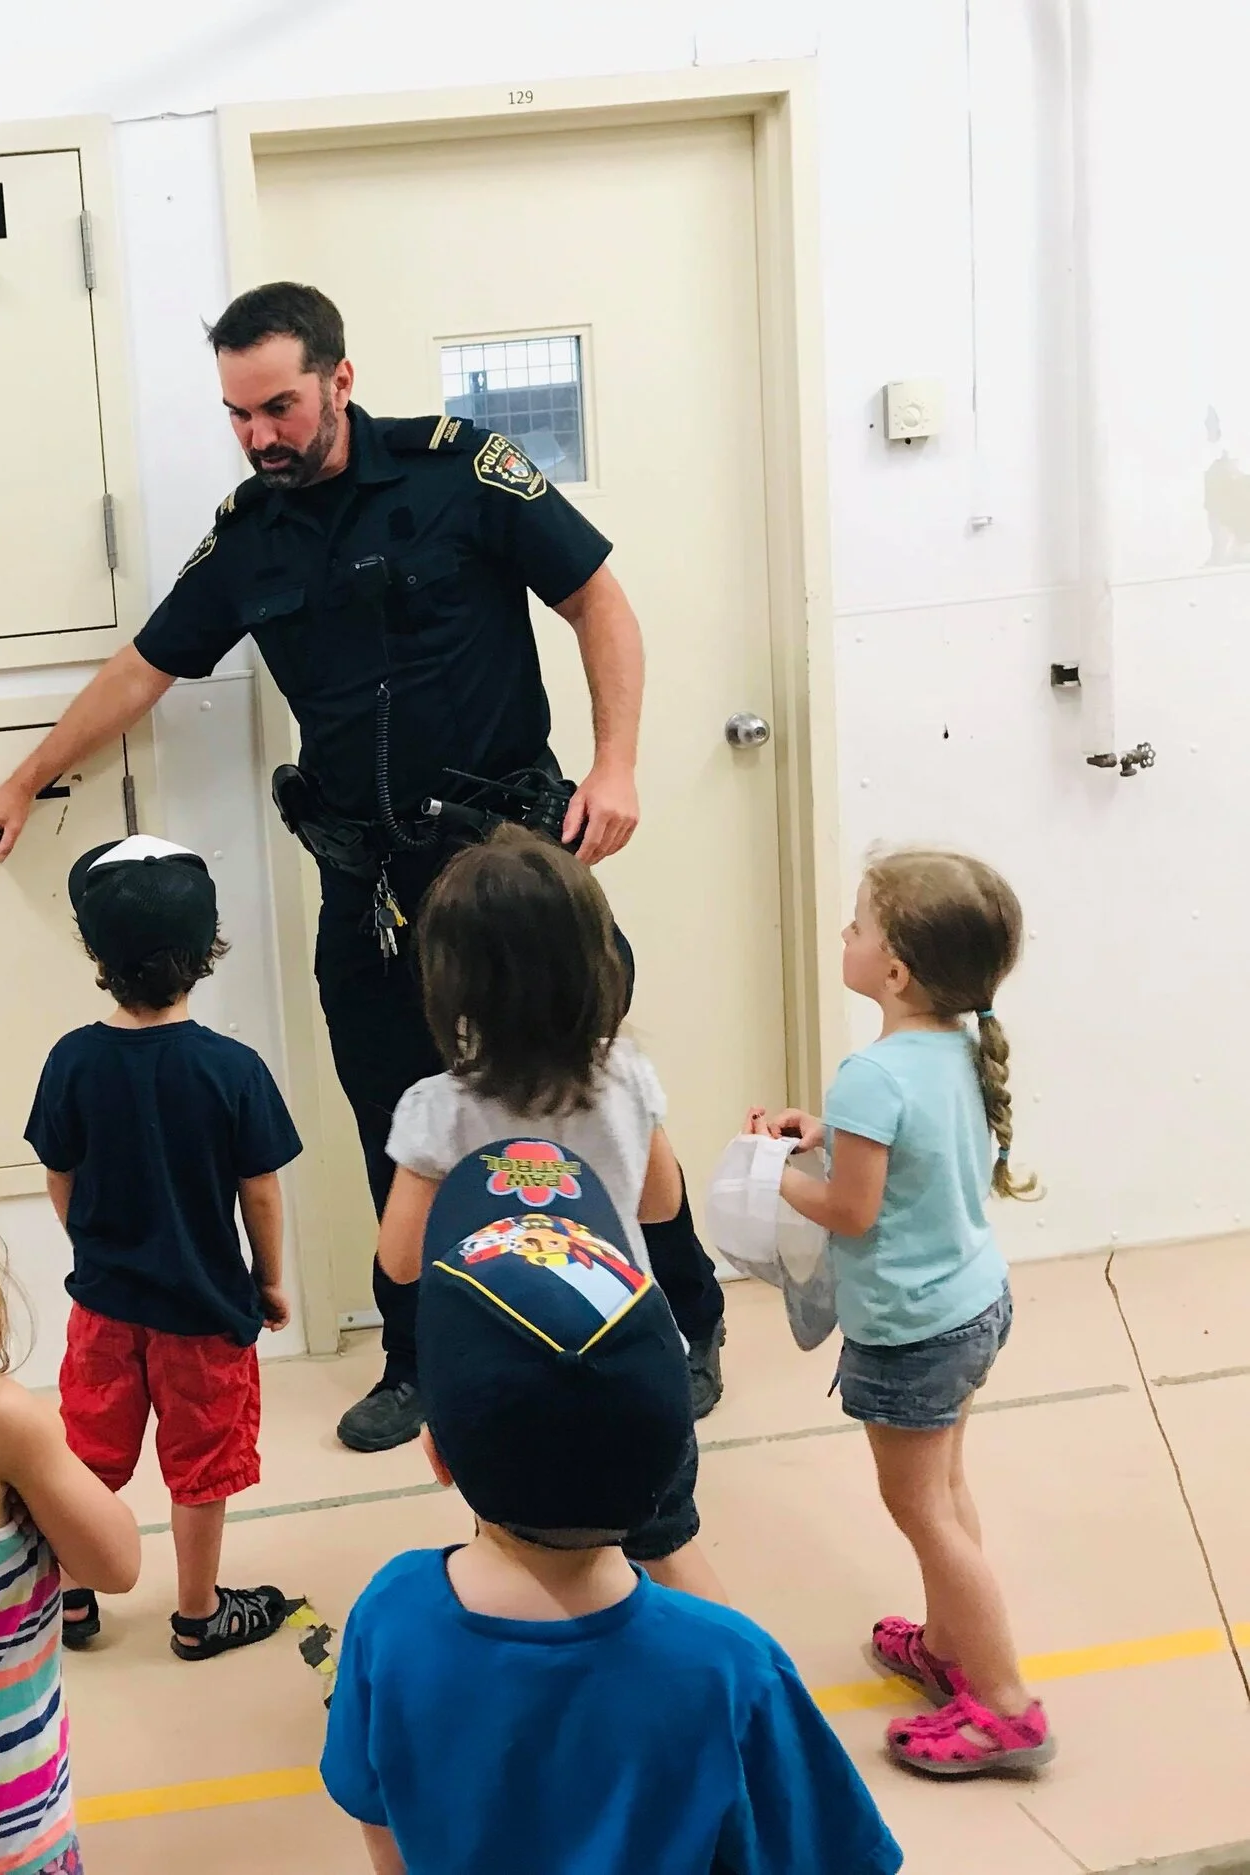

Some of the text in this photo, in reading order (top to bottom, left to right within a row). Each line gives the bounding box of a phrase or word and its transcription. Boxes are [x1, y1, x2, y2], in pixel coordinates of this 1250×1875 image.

[508, 90, 534, 105] 129
[480, 437, 510, 474] POLICE
[479, 1154, 582, 1175] PATROL
[506, 1173, 561, 1188] PAW
